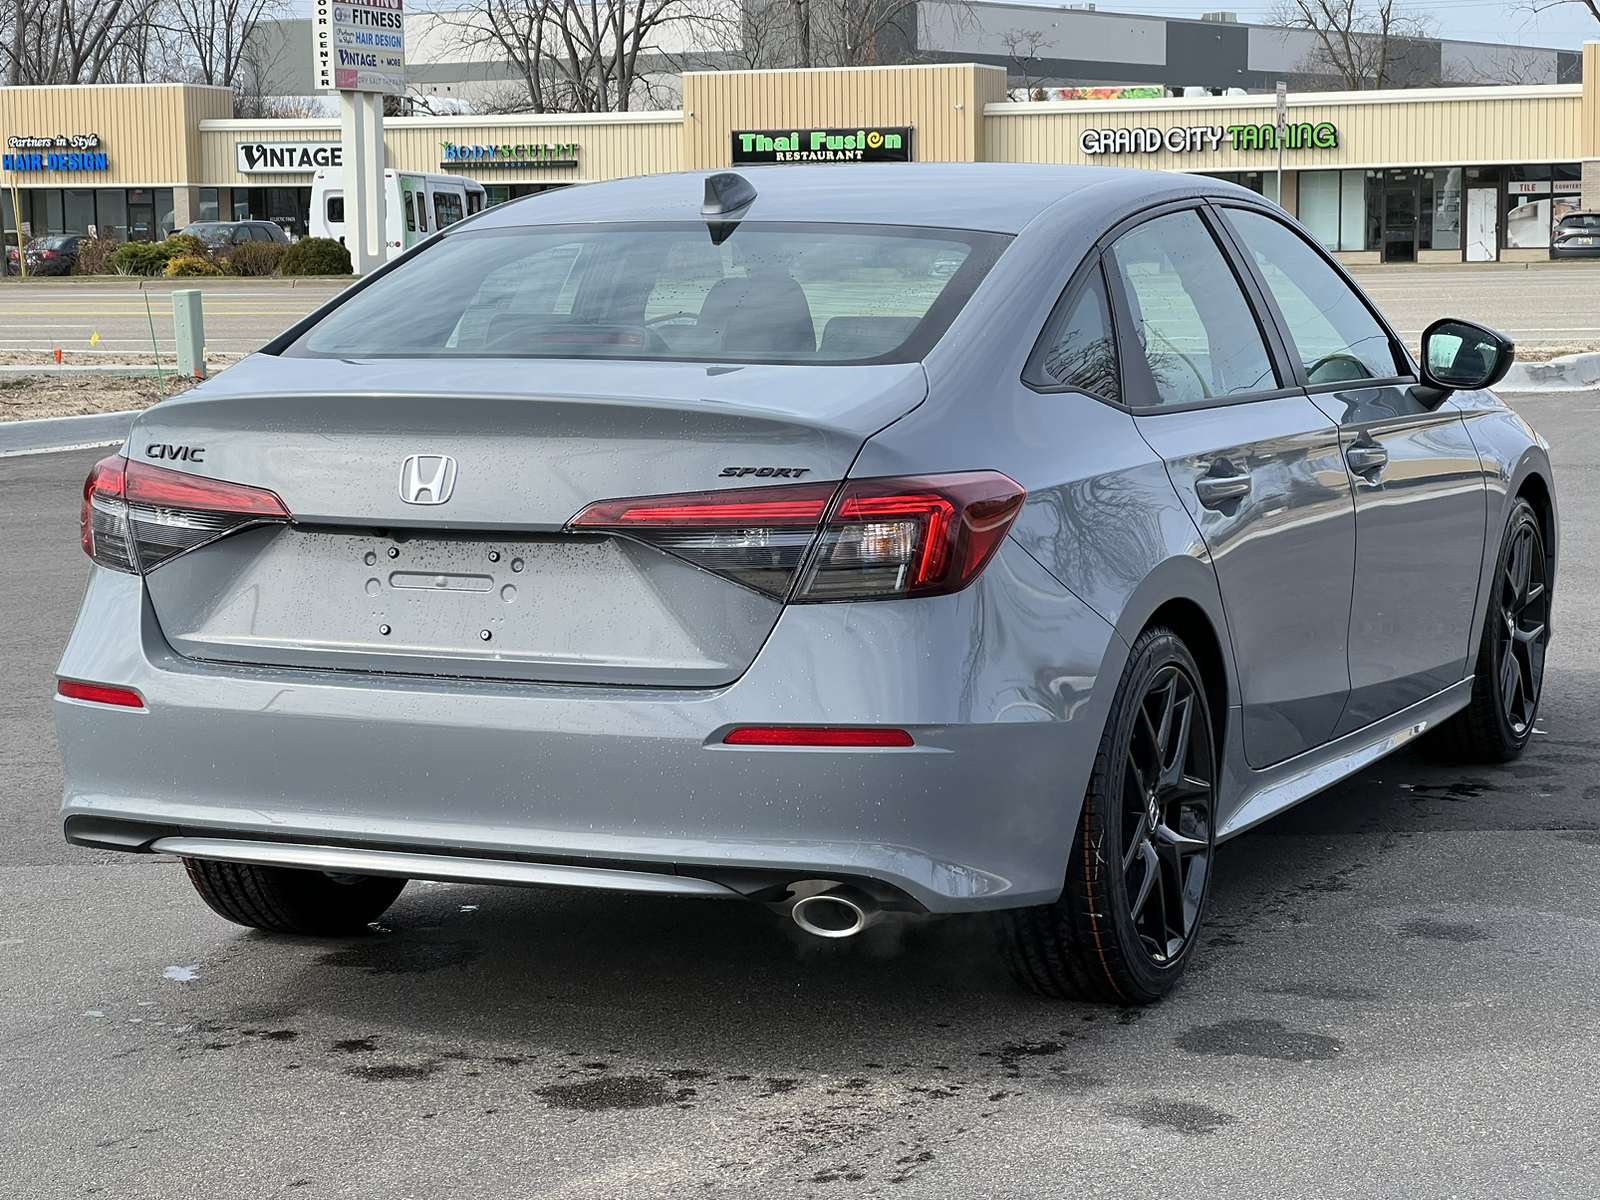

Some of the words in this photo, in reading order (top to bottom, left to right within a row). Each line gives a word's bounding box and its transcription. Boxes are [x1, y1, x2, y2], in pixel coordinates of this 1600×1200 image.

[353, 9, 402, 28] FITNESS
[355, 32, 373, 45] HAIR
[375, 33, 402, 48] DESIGN
[319, 32, 330, 86] CENTER
[338, 49, 377, 66] VINTAGE
[387, 58, 401, 66] MORE
[369, 77, 381, 85] SALT
[8, 136, 53, 148] Partners
[55, 134, 69, 147] in
[70, 133, 99, 150] Style
[739, 131, 799, 152] Thai
[810, 131, 902, 151] Fusion
[1079, 128, 1163, 155] GRAND
[1164, 126, 1223, 153] CITY
[241, 144, 342, 170] VINTAGE
[446, 143, 499, 160] BODY
[501, 143, 578, 158] SCULPT
[776, 150, 864, 161] RESTAURANT
[2, 154, 44, 171] HAIR
[47, 153, 108, 171] DESIGN
[145, 443, 206, 463] CIVIC
[717, 466, 811, 478] SPORT
